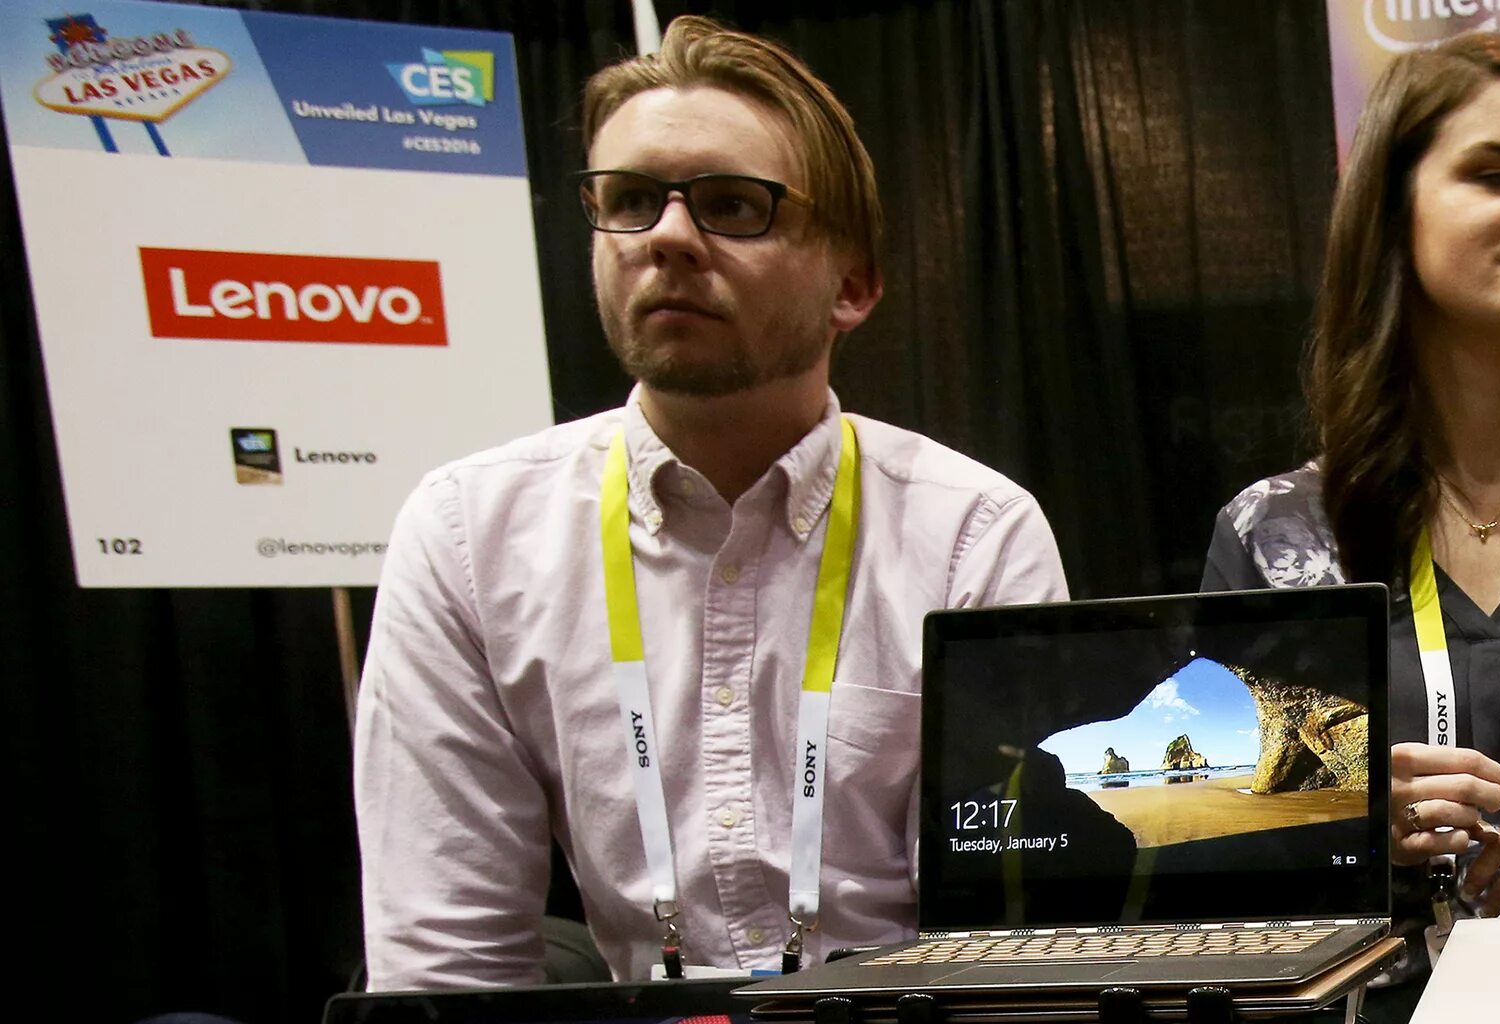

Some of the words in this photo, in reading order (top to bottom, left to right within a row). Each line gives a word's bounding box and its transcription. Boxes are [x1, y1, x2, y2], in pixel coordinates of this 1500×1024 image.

[63, 79, 118, 104] LAS
[121, 60, 216, 92] VEGAS
[401, 64, 475, 99] CES
[293, 100, 379, 122] Unveiled
[383, 107, 415, 124] Las
[418, 109, 477, 131] Vegas
[403, 136, 481, 155] #CES2016
[169, 268, 424, 325] Lenovo
[294, 447, 377, 464] Lenovo
[98, 538, 143, 555] 102
[1436, 691, 1448, 746] SONY
[631, 710, 650, 768] SONY
[803, 740, 817, 798] SONY
[950, 799, 1017, 831] 12:17
[949, 837, 1004, 853] Tuesday,
[1006, 834, 1056, 852] January
[1060, 834, 1068, 847] 5
